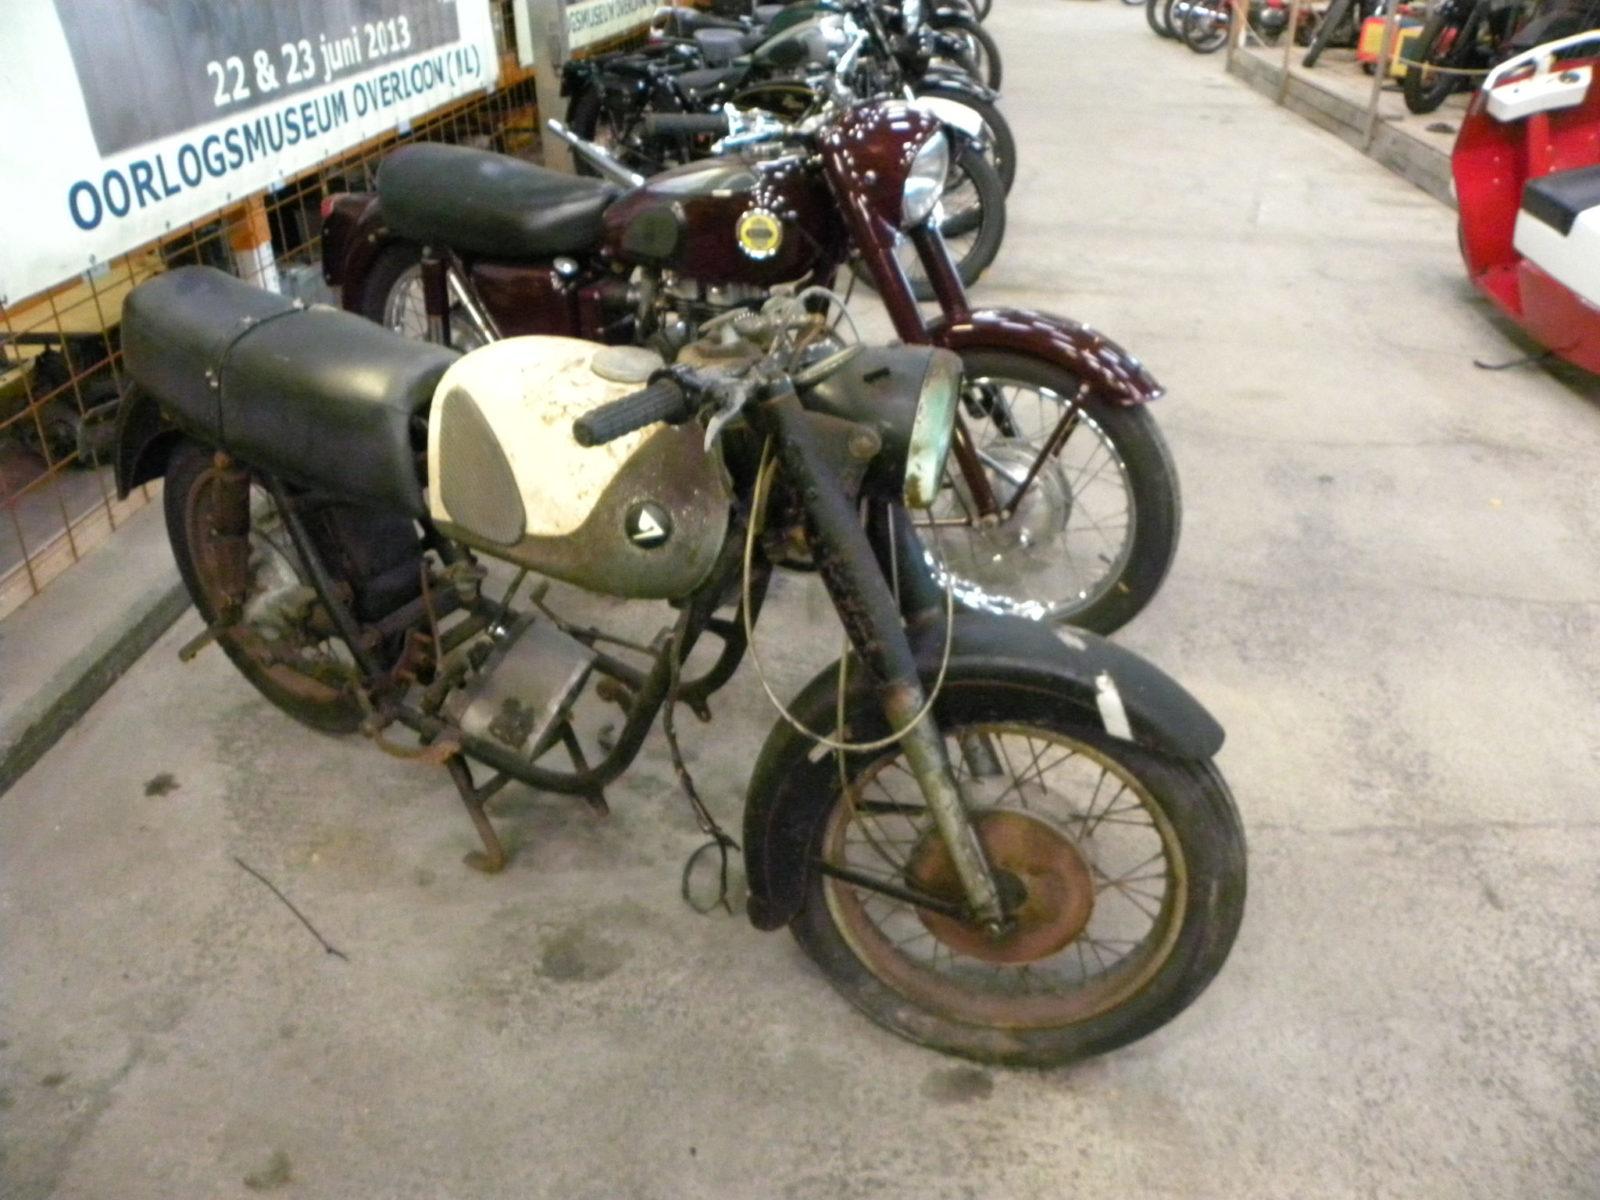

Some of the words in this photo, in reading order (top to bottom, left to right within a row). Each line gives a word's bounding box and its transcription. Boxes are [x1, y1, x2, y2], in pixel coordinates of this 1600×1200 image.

[206, 56, 251, 107] 22
[253, 49, 281, 93] &
[281, 39, 316, 84] 23
[319, 26, 363, 83] juni
[364, 15, 412, 59] 2013
[68, 90, 349, 231] OORLOGSMUSEUM
